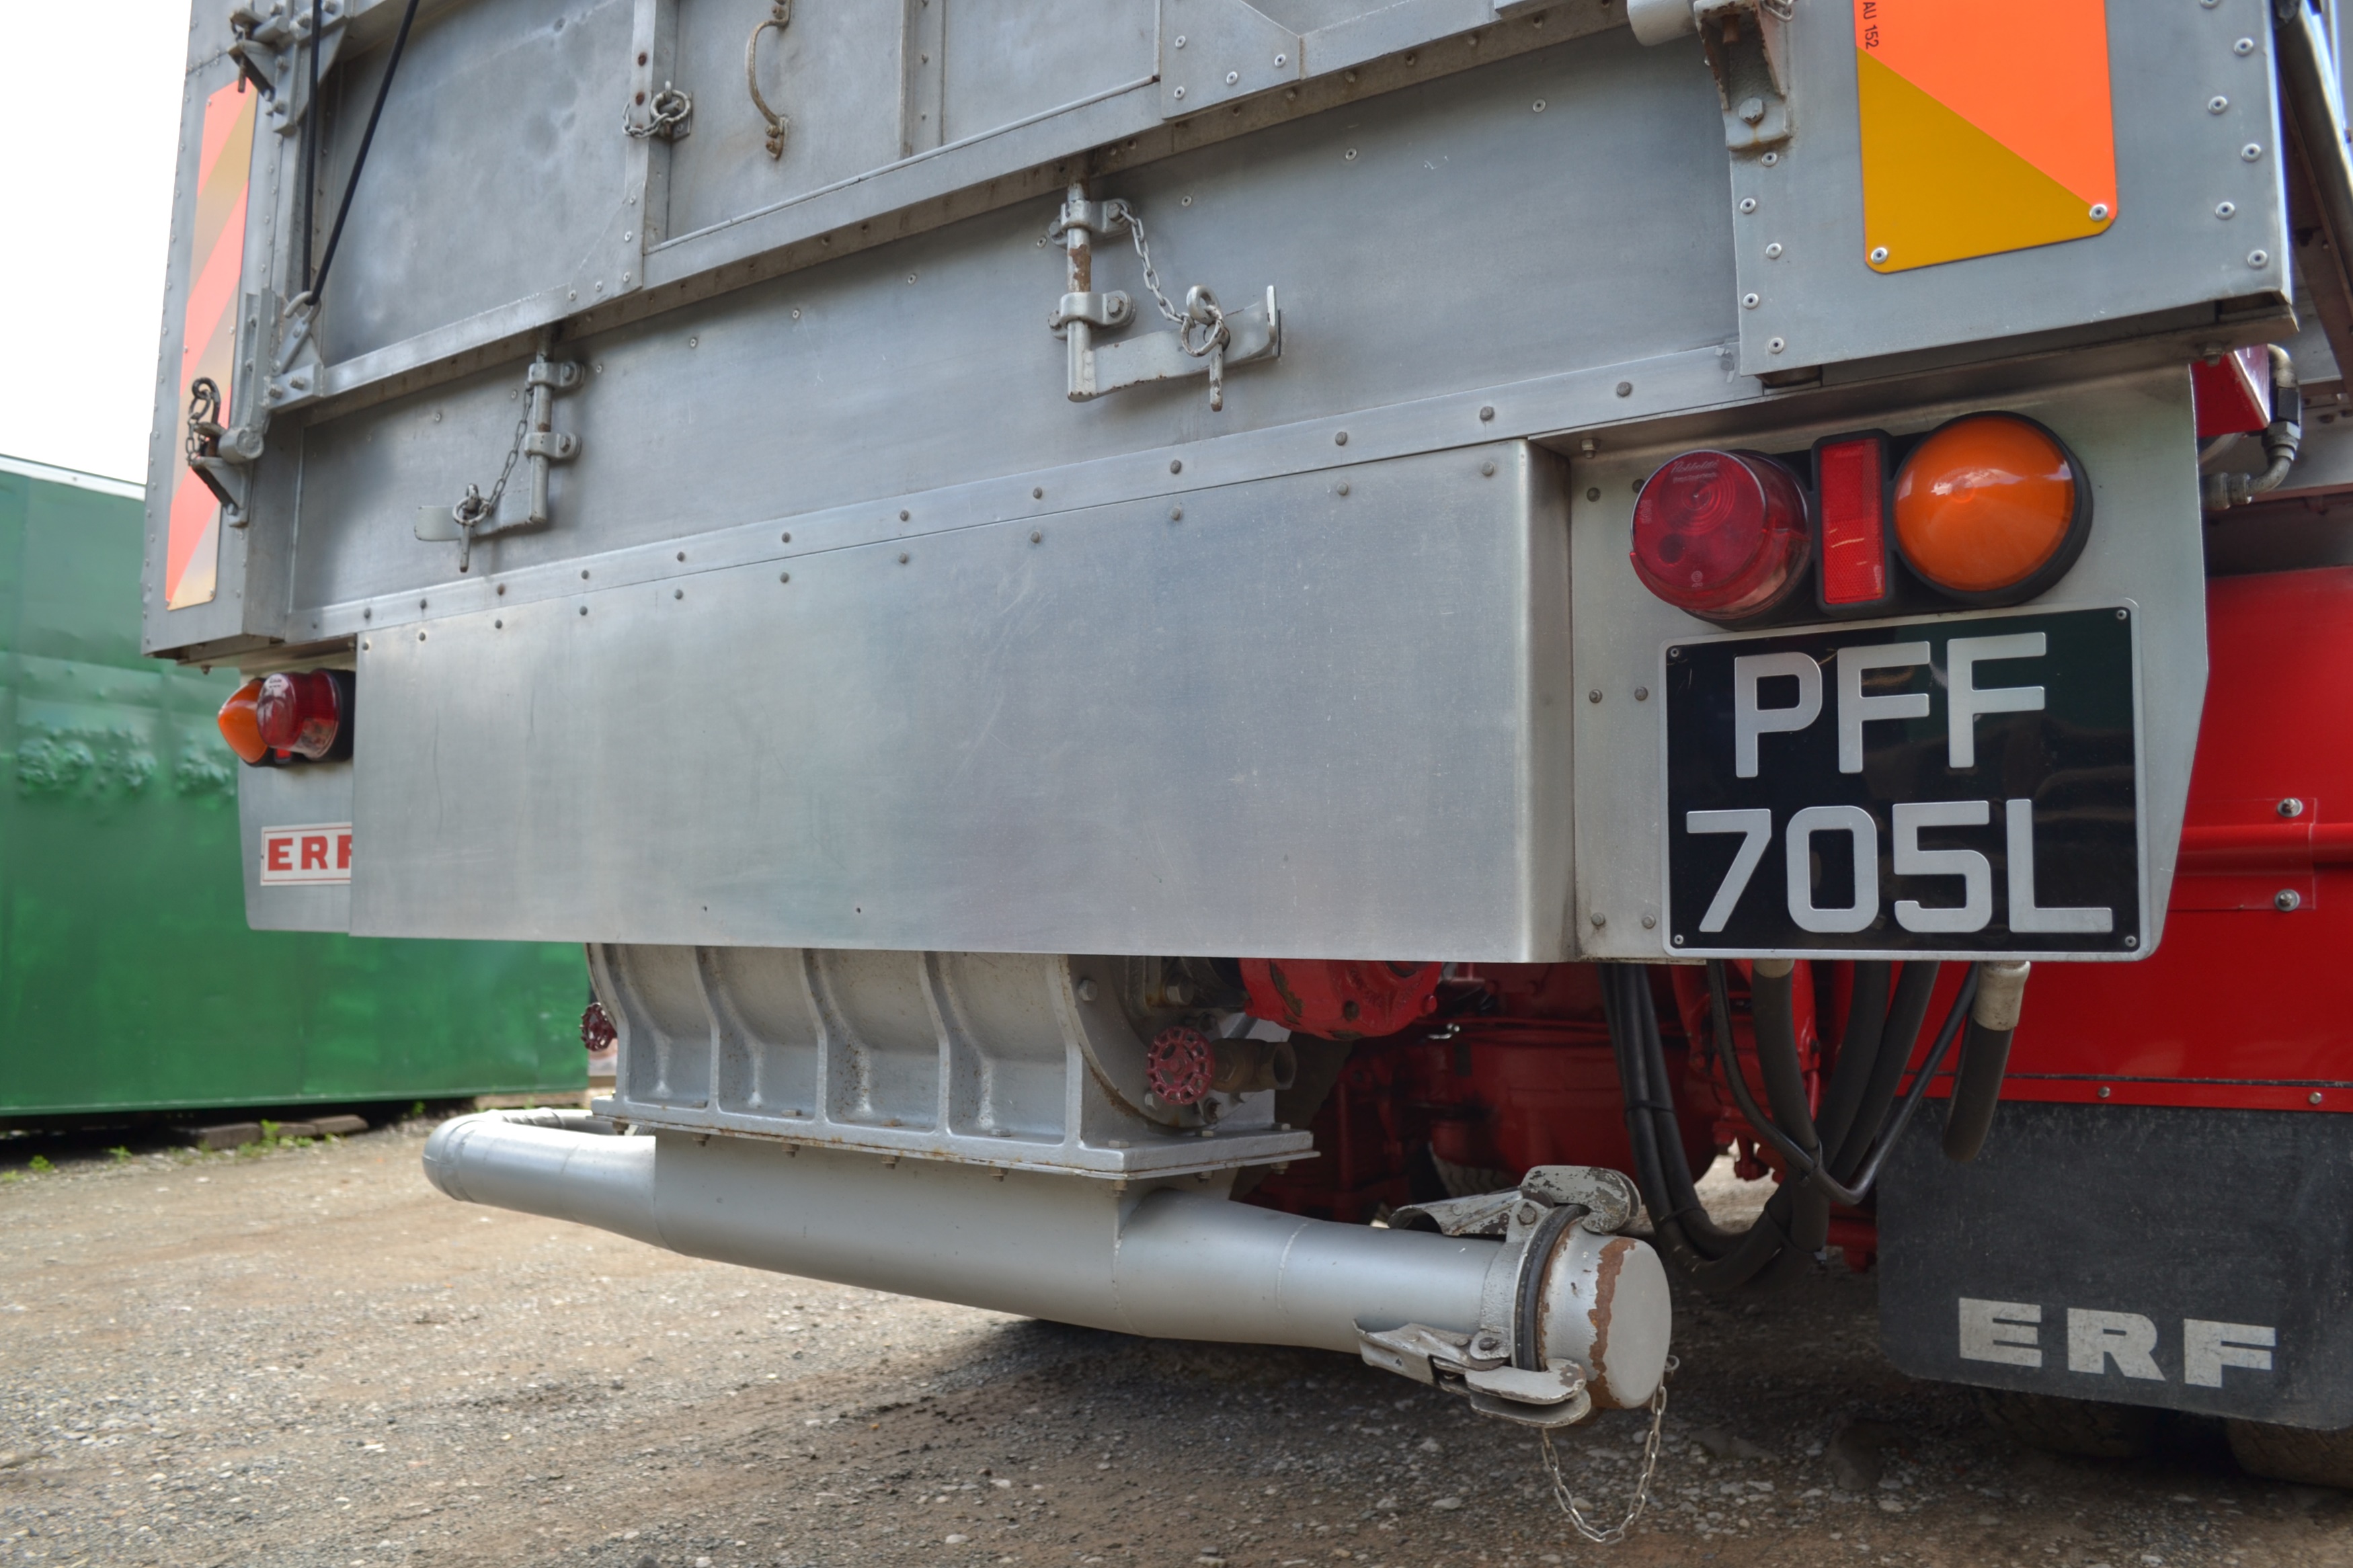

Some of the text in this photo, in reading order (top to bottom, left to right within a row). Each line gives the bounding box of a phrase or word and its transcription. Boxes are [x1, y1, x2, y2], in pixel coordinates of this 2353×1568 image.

[1863, 2, 1879, 50] AU 152
[1734, 632, 2046, 778] PFF
[1686, 798, 2113, 933] 705L
[1959, 1297, 2276, 1388] ERF
